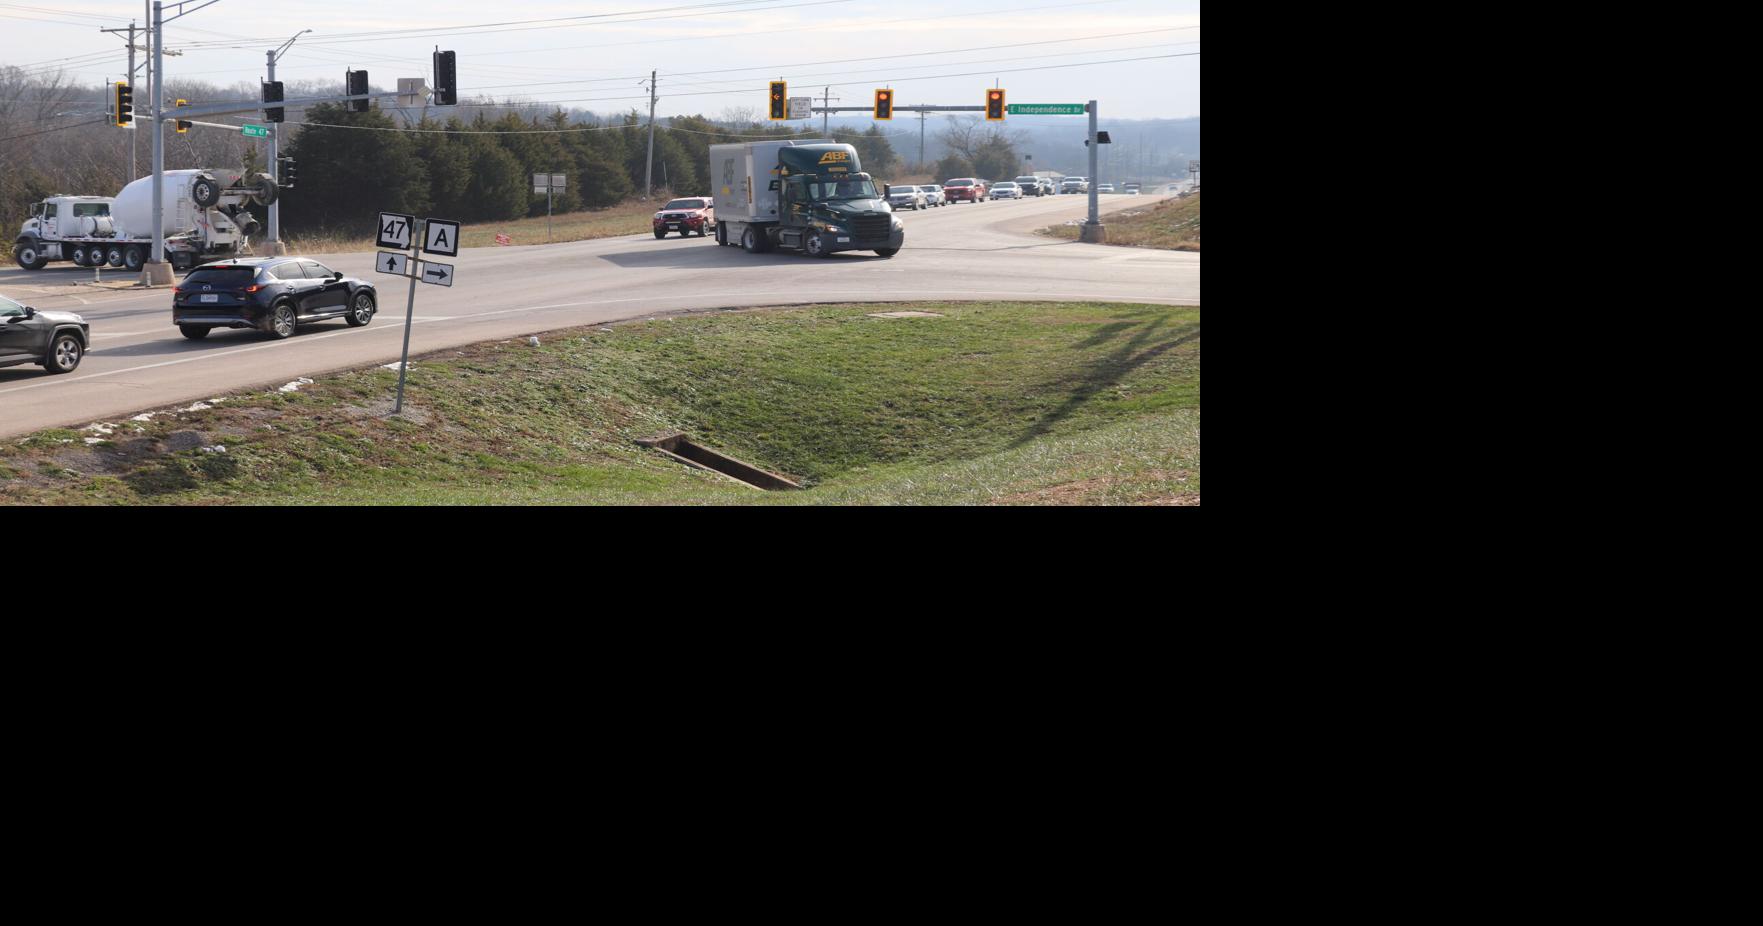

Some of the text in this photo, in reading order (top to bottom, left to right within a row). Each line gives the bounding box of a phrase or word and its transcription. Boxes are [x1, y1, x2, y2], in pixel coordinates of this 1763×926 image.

[1018, 105, 1071, 113] Independence
[821, 151, 849, 161] ABF
[383, 219, 406, 240] 47
[433, 228, 449, 248] A
